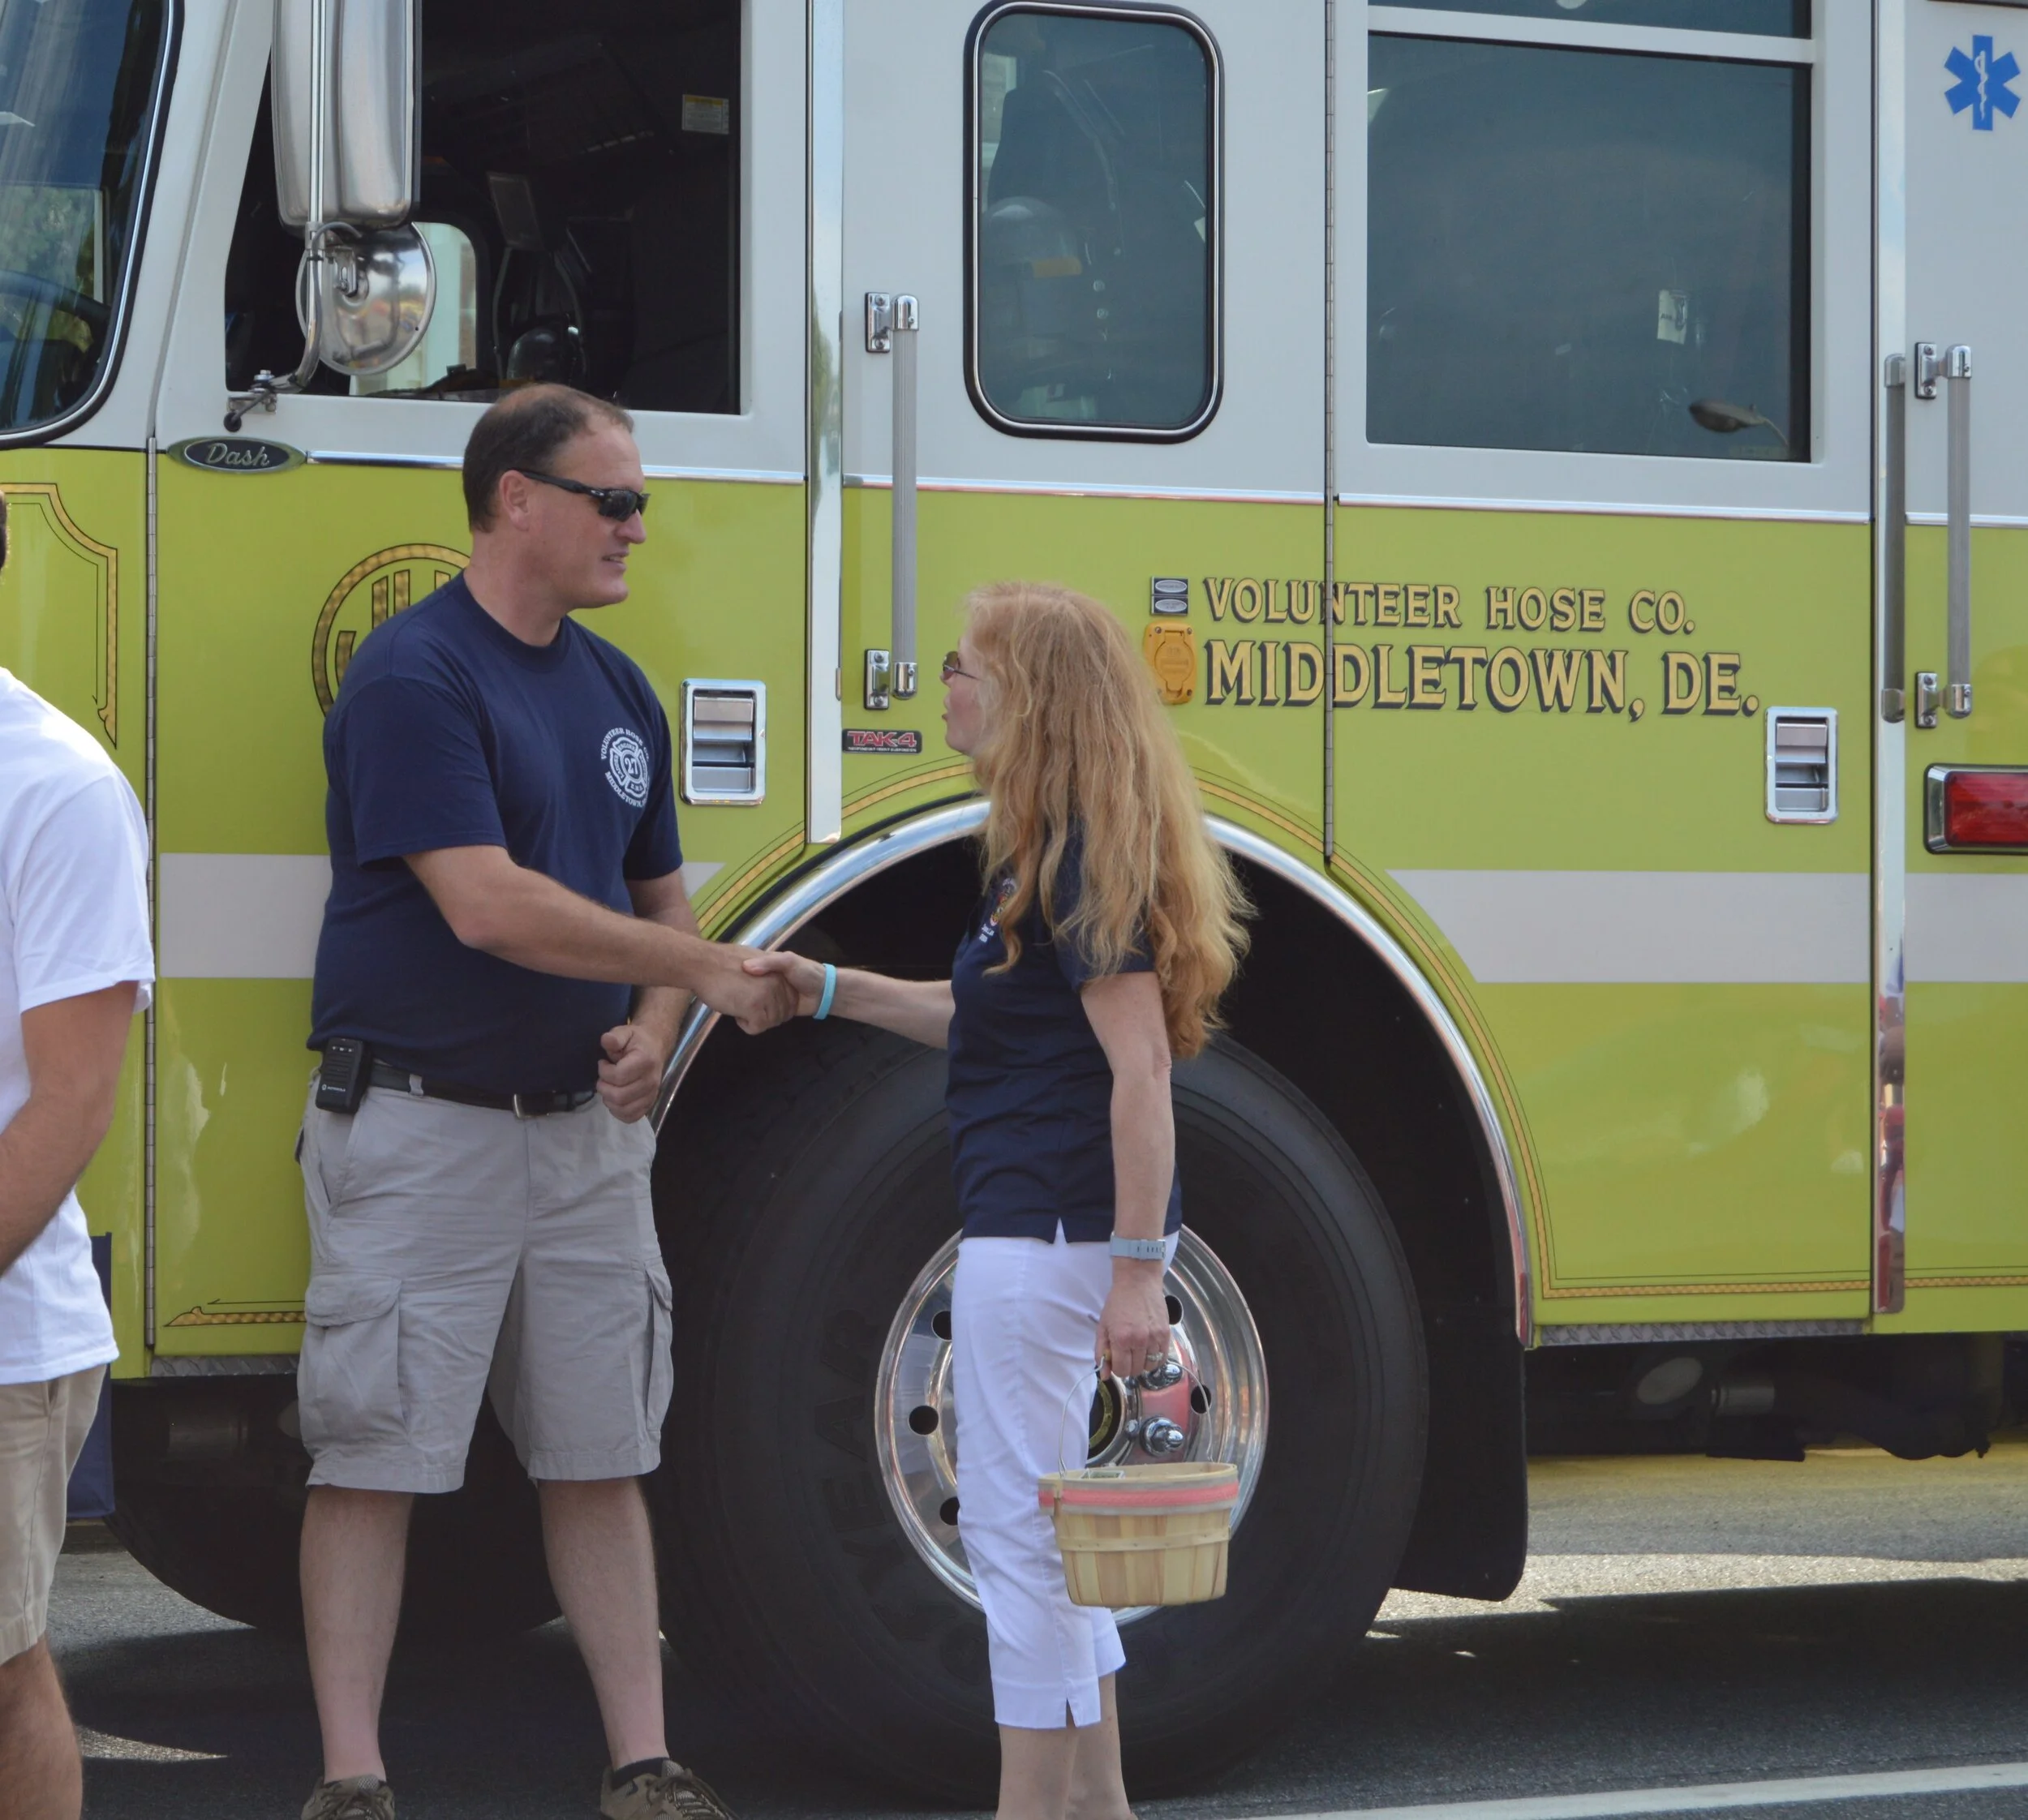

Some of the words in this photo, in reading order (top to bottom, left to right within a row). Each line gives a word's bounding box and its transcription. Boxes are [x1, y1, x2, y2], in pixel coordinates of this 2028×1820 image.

[205, 442, 270, 466] Dash
[1203, 577, 1462, 627] VOLUNTEER
[1484, 586, 1605, 631] HOSE
[1628, 589, 1695, 635] CO.
[1204, 639, 1643, 723] MIDDLETOWN,
[1661, 652, 1759, 716] DE.
[600, 728, 625, 760] VOLUNTEER
[847, 731, 917, 747] TAK-4
[625, 758, 638, 775] 27
